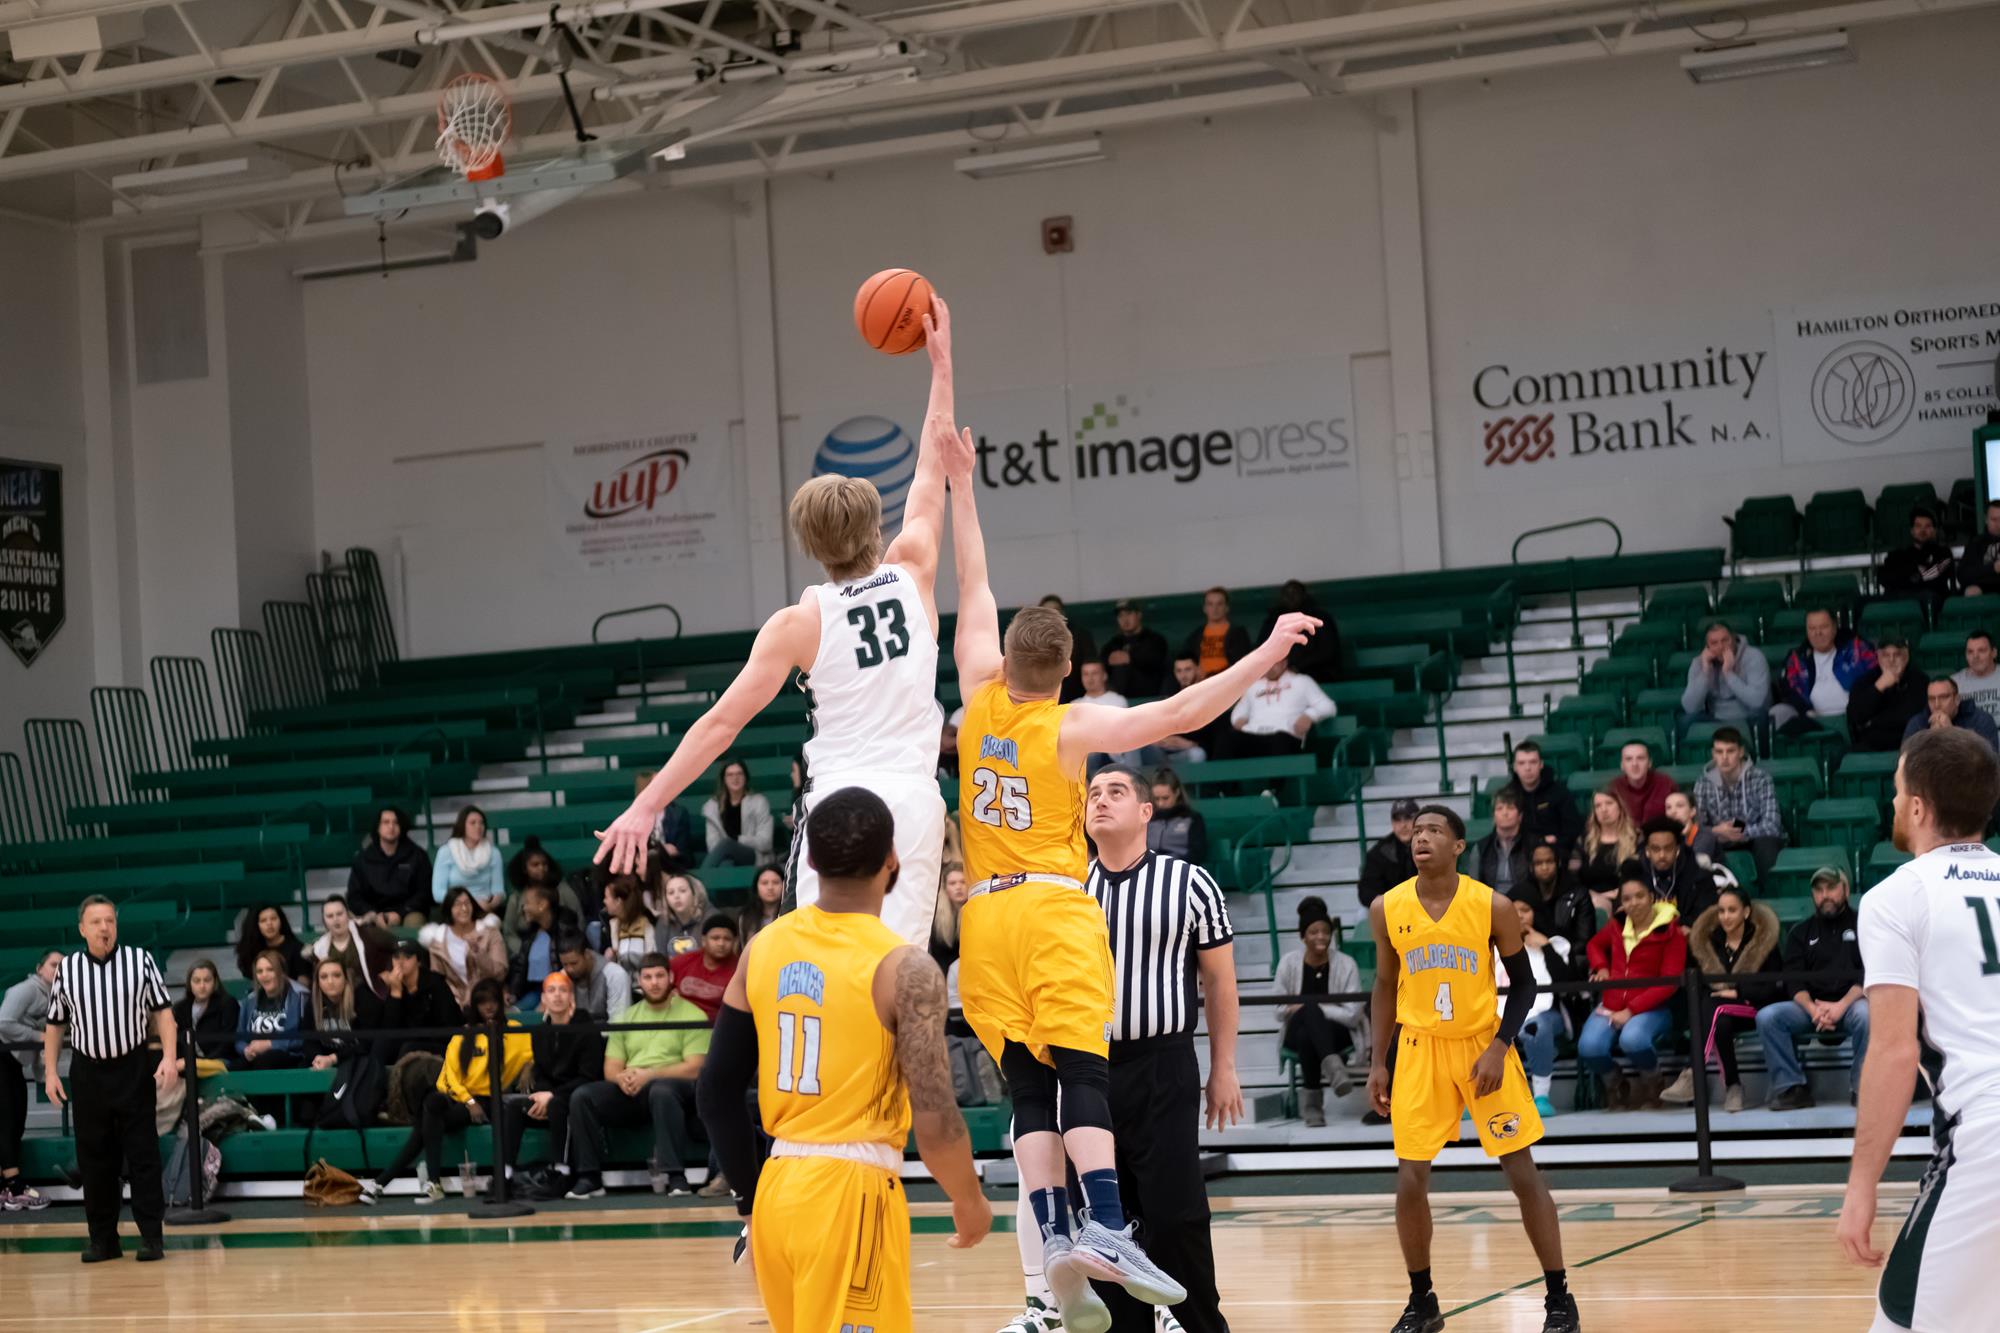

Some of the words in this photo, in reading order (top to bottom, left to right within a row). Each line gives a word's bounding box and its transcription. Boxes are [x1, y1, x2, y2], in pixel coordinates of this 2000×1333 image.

[1796, 314, 1889, 338] HAMILTON
[1910, 333, 1980, 355] SPORTS
[1473, 346, 1768, 411] Community
[1924, 390, 1941, 403] 85
[1567, 400, 1697, 458] Bank
[593, 458, 679, 511] uup
[945, 429, 1060, 492] t&t
[0, 589, 51, 614] 2011-12
[847, 598, 910, 670] 33
[972, 767, 1033, 831] 25
[1950, 844, 1969, 853] NIKE
[1404, 944, 1479, 976] WILDCATS
[1964, 896, 2000, 977] 1
[1434, 982, 1454, 1021] 4
[776, 1011, 822, 1096] 11
